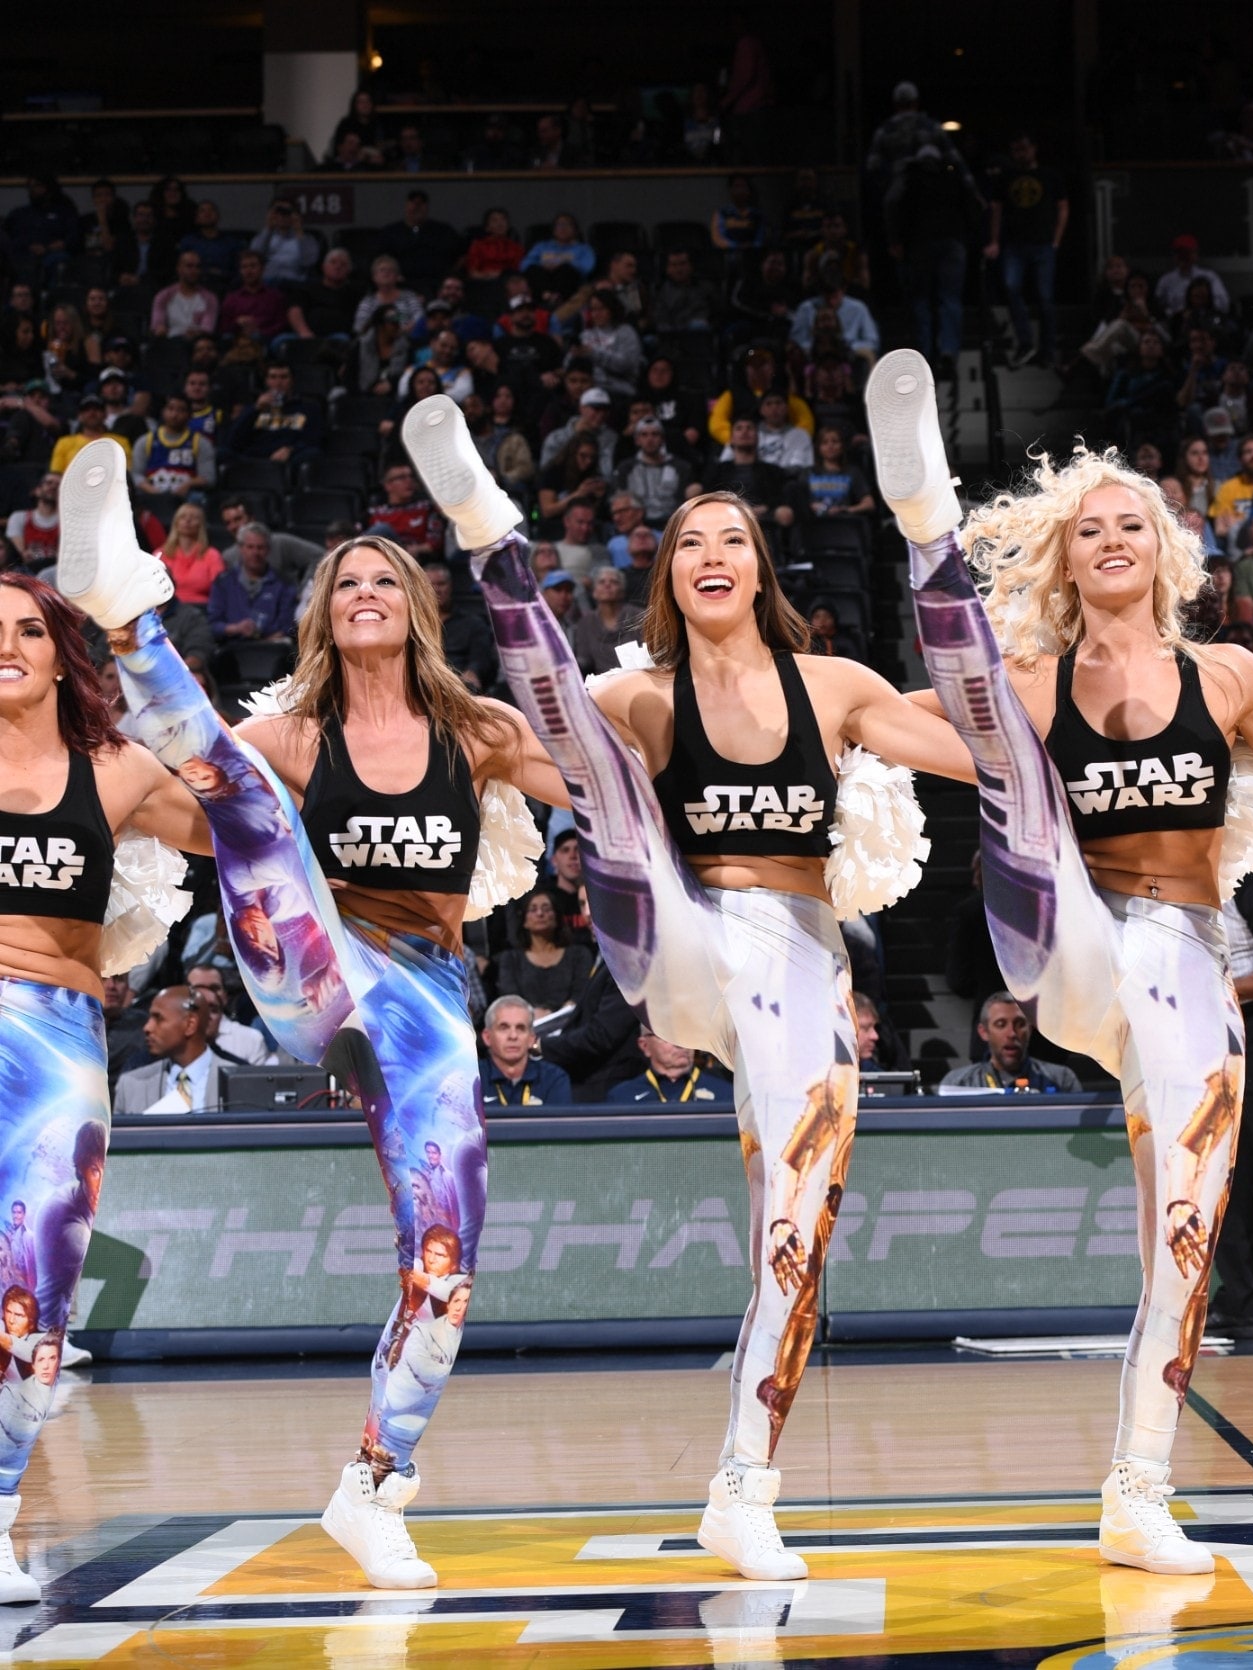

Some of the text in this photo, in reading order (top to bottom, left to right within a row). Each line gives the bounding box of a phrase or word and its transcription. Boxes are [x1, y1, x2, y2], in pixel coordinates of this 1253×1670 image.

[297, 193, 342, 215] 148
[1066, 752, 1214, 792] STAR
[684, 785, 825, 813] STAR
[1068, 777, 1215, 815] WARS
[329, 815, 461, 844] STAR
[685, 811, 824, 835] WARS
[330, 843, 461, 869] WARS
